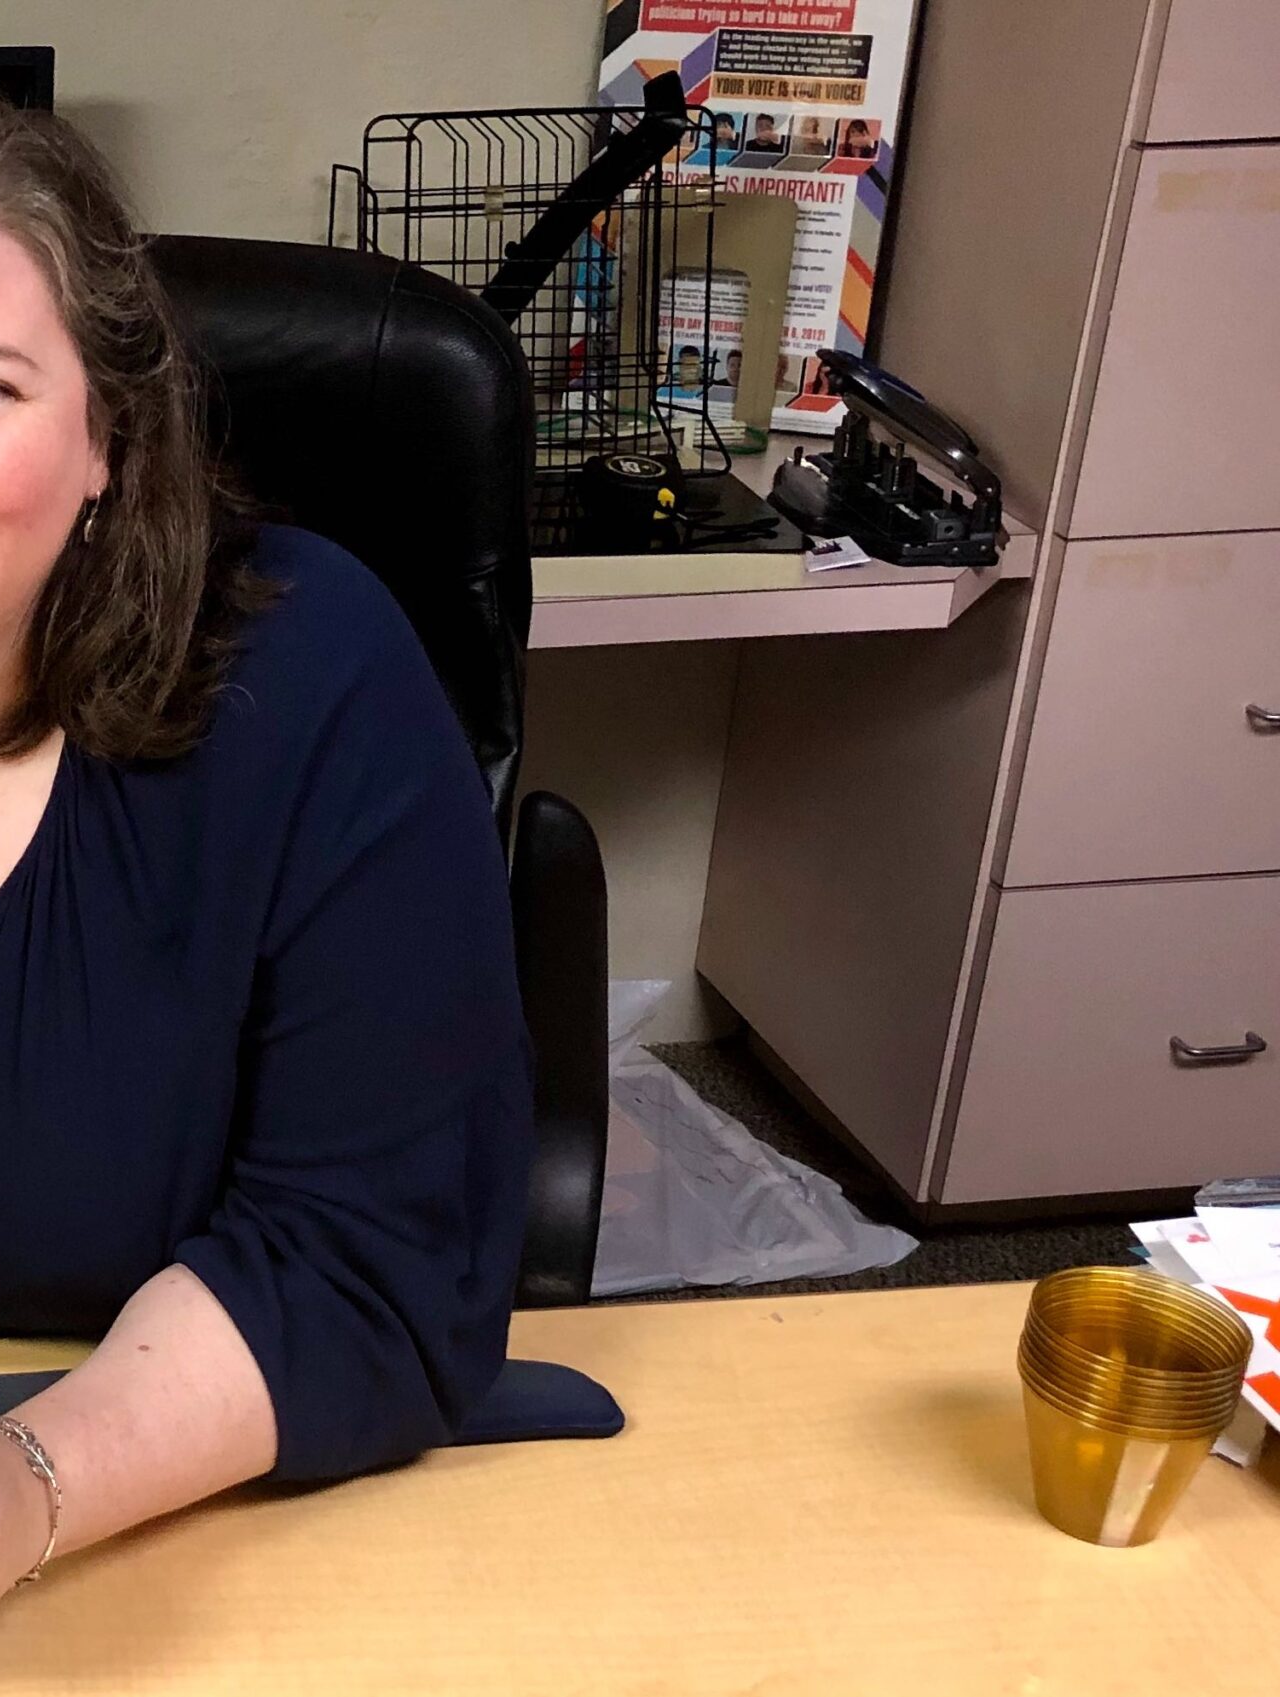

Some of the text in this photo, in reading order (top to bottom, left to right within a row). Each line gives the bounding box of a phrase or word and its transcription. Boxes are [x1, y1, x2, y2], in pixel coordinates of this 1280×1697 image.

[698, 8, 726, 23] trying
[728, 10, 740, 22] so
[742, 9, 764, 23] hard
[766, 11, 776, 24] to
[778, 11, 798, 25] take
[800, 12, 808, 25] it
[810, 12, 842, 28] away?
[717, 78, 862, 101] YOUR VOTE IS YOUR VOICE!
[742, 176, 845, 204] IMPORTANT!
